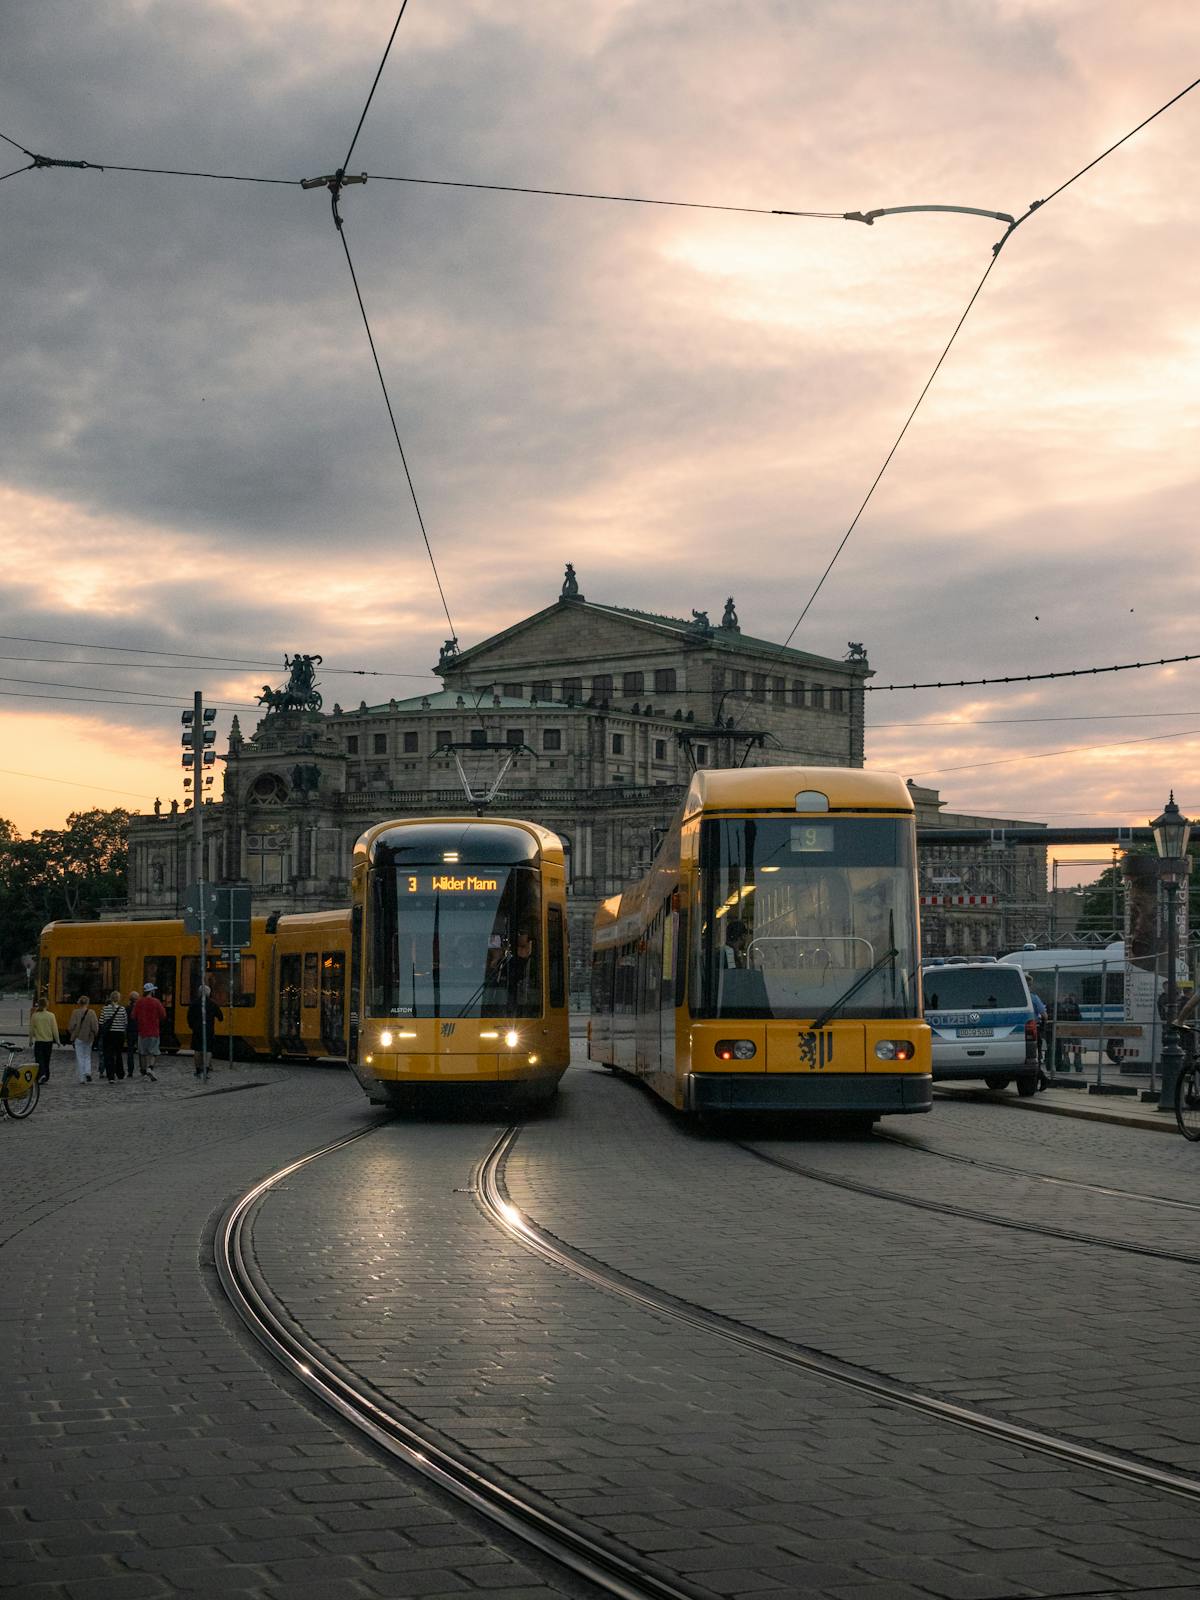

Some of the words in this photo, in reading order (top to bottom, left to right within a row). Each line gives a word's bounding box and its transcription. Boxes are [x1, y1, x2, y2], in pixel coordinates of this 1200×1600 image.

[805, 828, 817, 846] 9
[408, 877, 417, 892] 3
[432, 876, 465, 891] Wilder
[467, 876, 497, 890] Mann
[925, 1015, 969, 1026] POLIZEI
